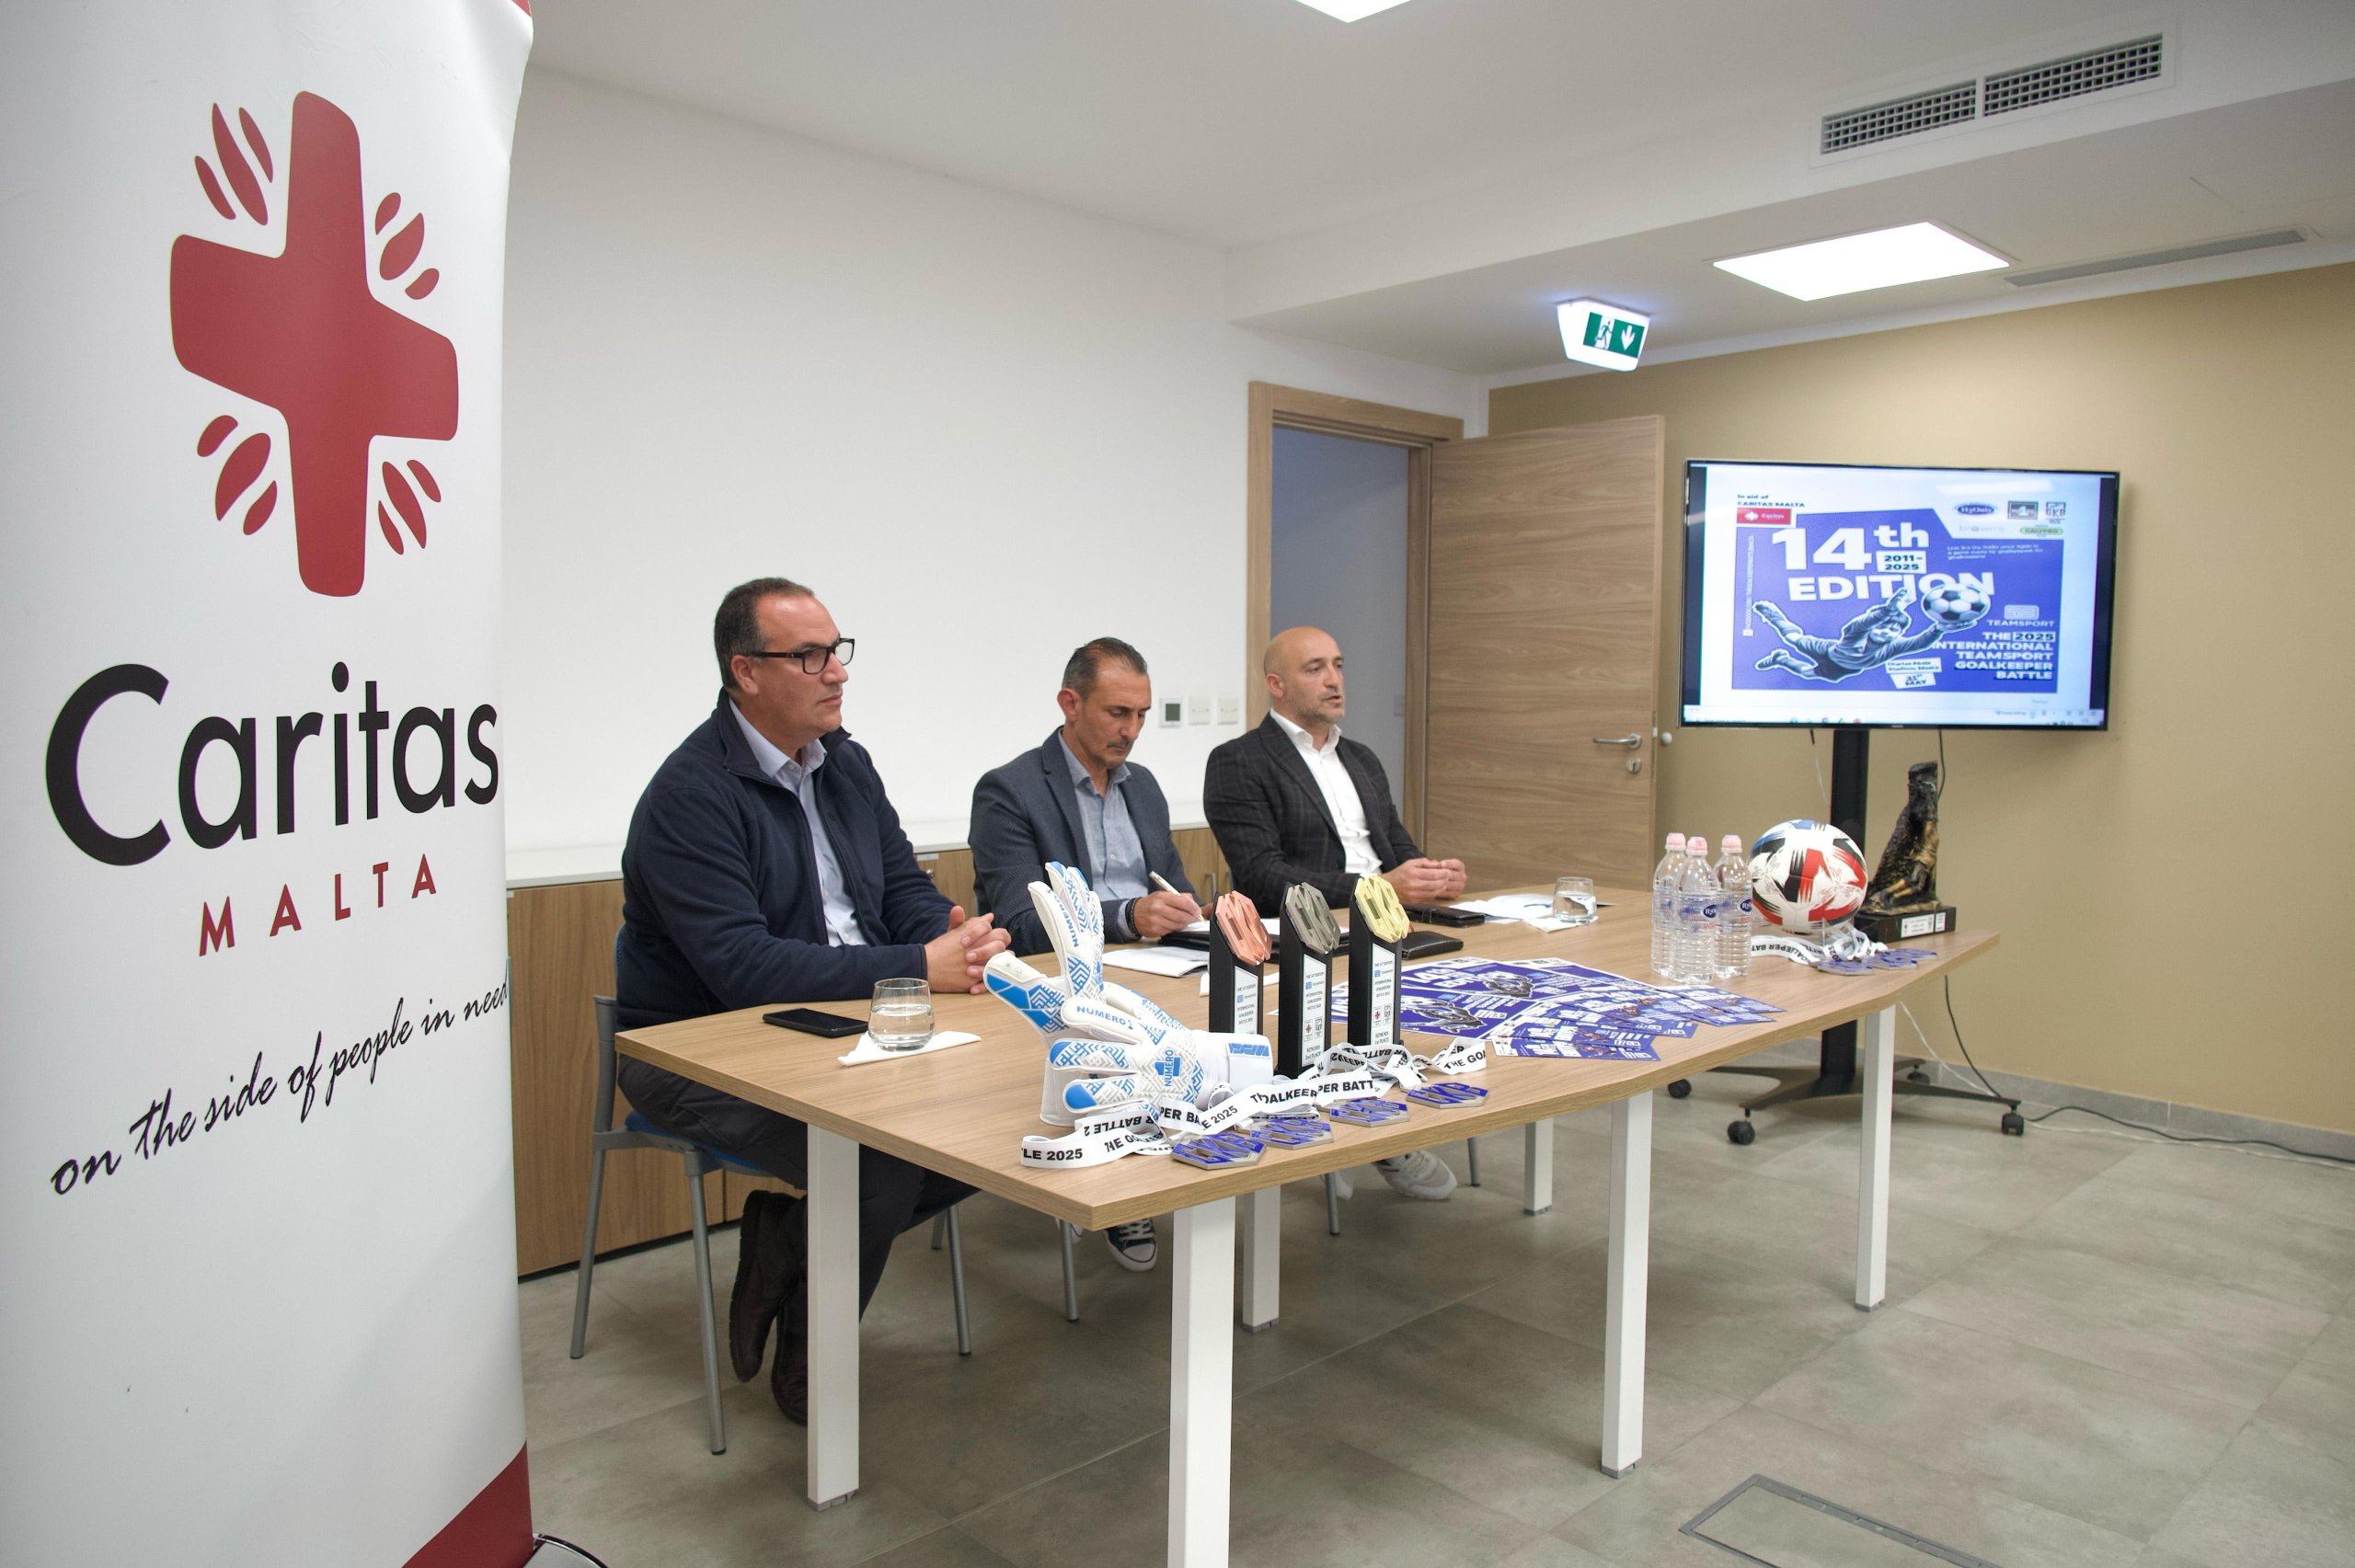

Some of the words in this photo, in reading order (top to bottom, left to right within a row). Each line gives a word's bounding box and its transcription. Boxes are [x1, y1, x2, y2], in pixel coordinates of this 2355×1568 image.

[1772, 522, 1930, 571] 14th
[1787, 572, 1994, 601] EDITION
[1987, 619, 2055, 627] TEAMSPORT
[1982, 632, 2011, 640] THE
[1955, 660, 2053, 670] GOALKEEPER
[1956, 651, 2053, 660] TEAMSPORT
[1996, 671, 2053, 680] BATTLE
[46, 661, 500, 866] Caritas
[199, 853, 436, 957] MALTA
[1076, 1005, 1126, 1025] NUMERO
[1128, 1017, 1135, 1030] 1
[51, 1150, 121, 1196] on
[129, 1088, 197, 1161] the
[204, 1051, 277, 1133] side
[287, 1030, 322, 1124] of
[325, 997, 414, 1107] people
[420, 999, 455, 1032] in
[463, 959, 508, 1022] need
[1165, 1049, 1175, 1087] NUMERO
[1211, 1105, 1238, 1124] 2025
[1047, 1148, 1083, 1162] 2025
